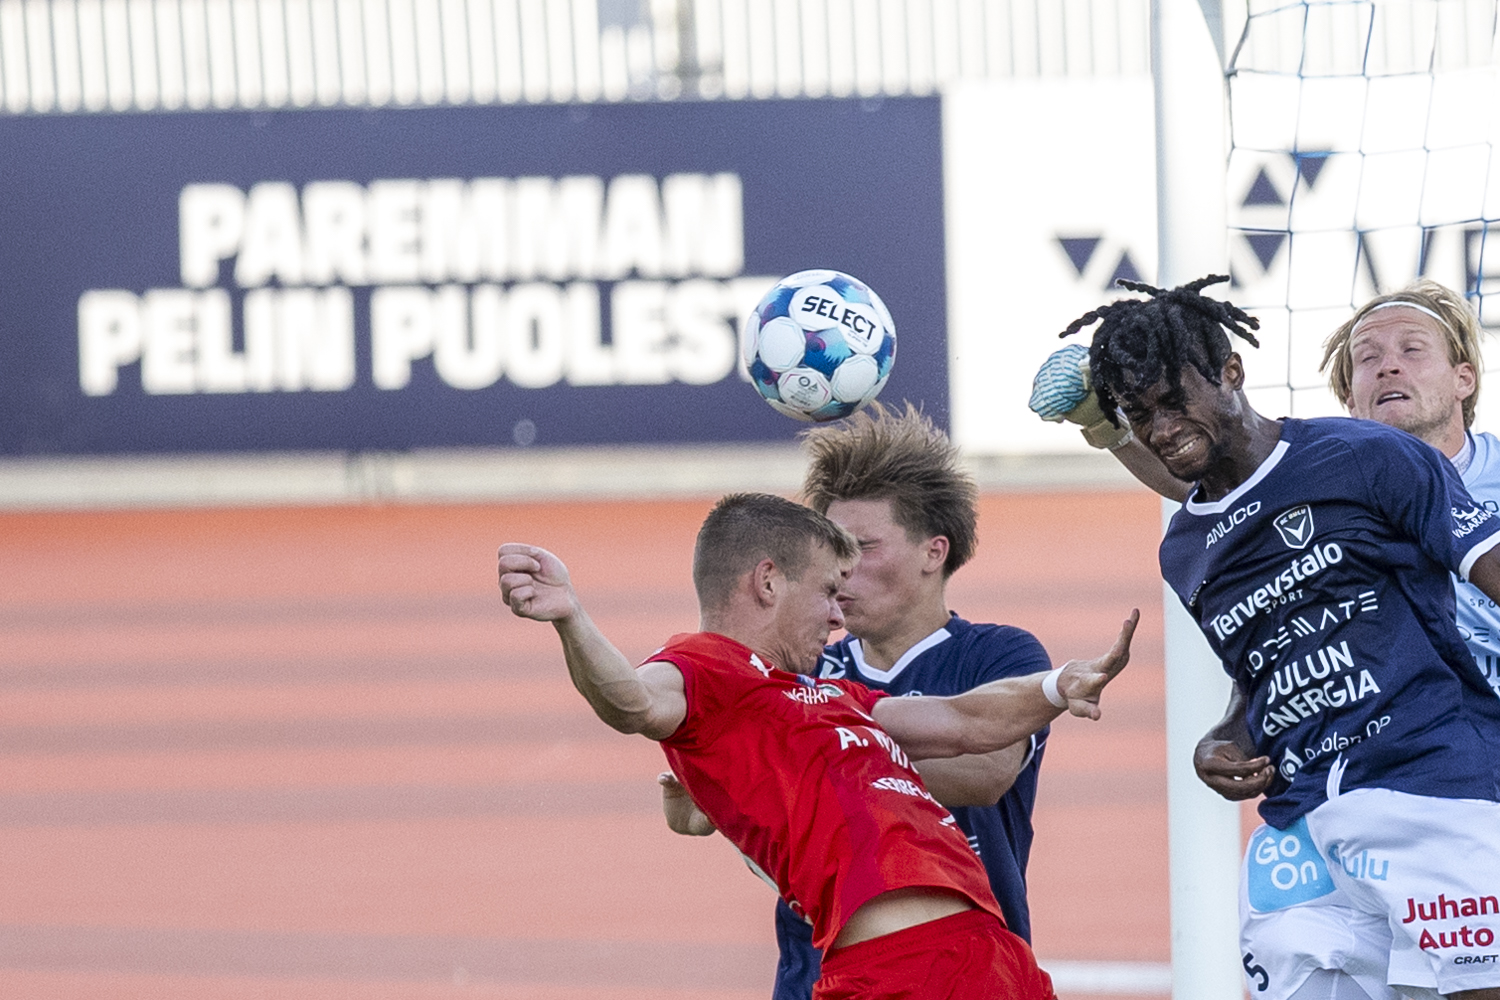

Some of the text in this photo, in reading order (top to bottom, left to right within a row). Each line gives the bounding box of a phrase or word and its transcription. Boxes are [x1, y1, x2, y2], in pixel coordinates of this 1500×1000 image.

[178, 170, 746, 289] PAREMMAN
[801, 295, 877, 341] SELECT
[77, 281, 357, 398] PELIN
[1205, 500, 1262, 550] ANUCO
[1263, 588, 1305, 615] SPORT
[1469, 597, 1497, 609] SPO
[1262, 668, 1382, 738] ENERGIA
[1254, 834, 1301, 866] Go
[1270, 859, 1318, 891] On
[1402, 892, 1500, 925] Juhan
[1418, 924, 1495, 952] Auto
[1453, 953, 1500, 966] CRAFT
